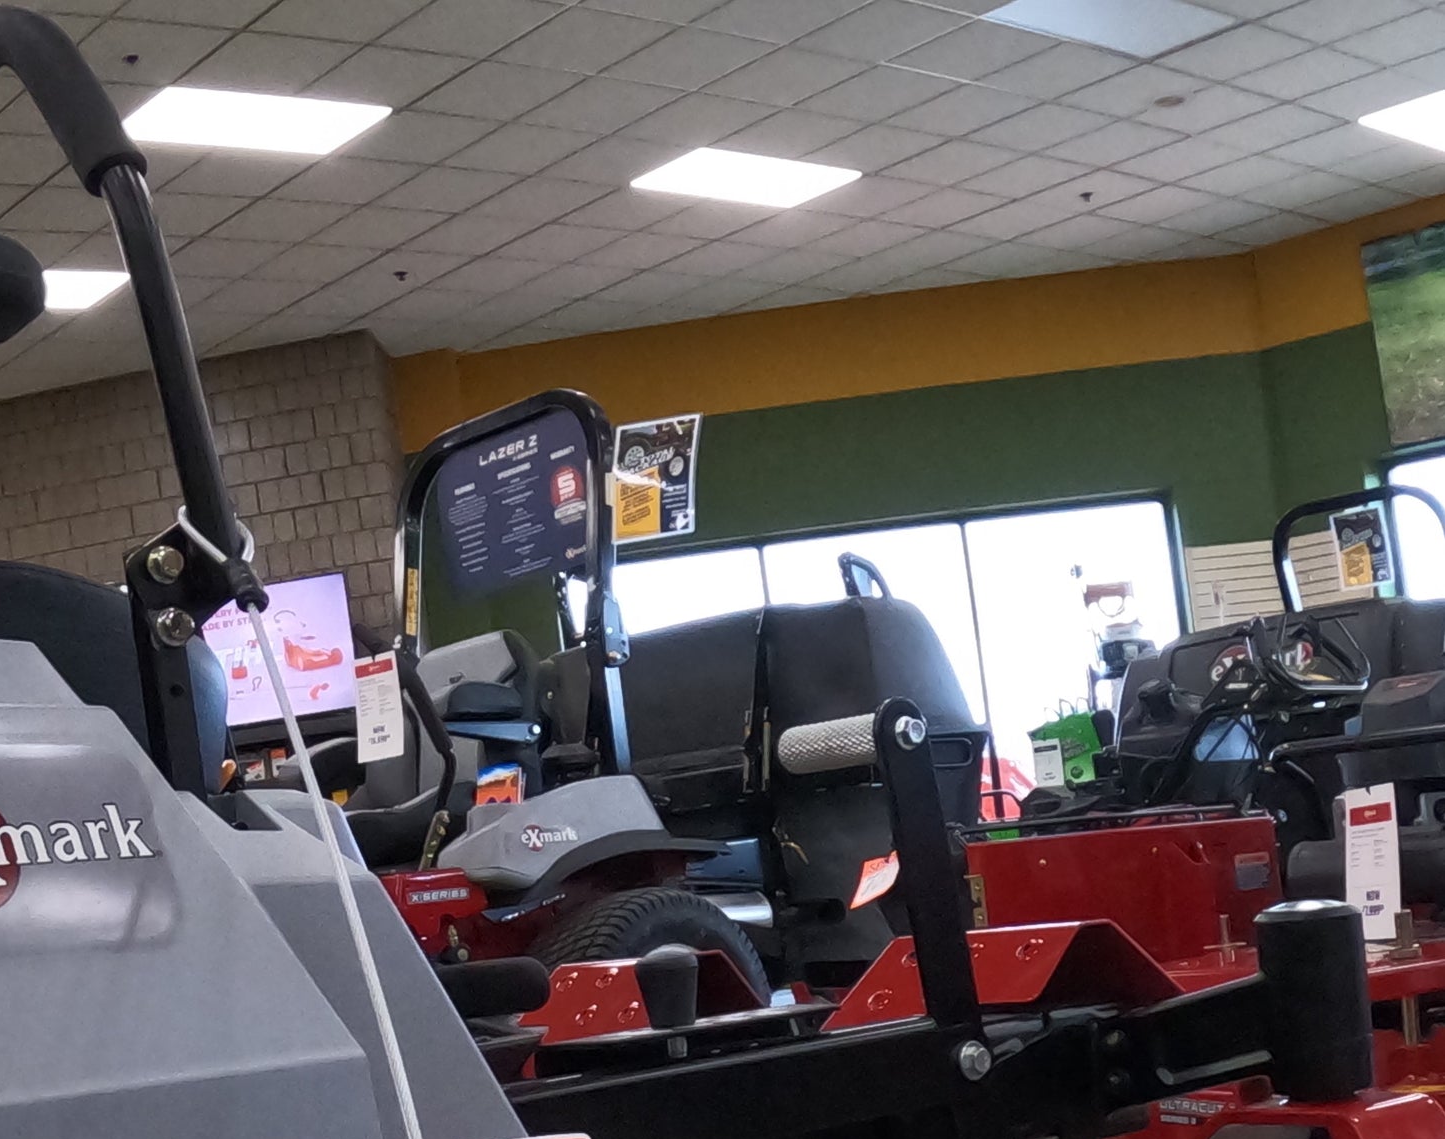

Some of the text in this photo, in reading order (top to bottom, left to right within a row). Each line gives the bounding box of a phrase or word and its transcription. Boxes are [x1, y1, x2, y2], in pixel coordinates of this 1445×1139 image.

[479, 439, 528, 466] LAZER
[527, 434, 539, 450] Z
[203, 622, 221, 631] ADE
[222, 620, 234, 628] BY
[520, 825, 578, 849] eXmark
